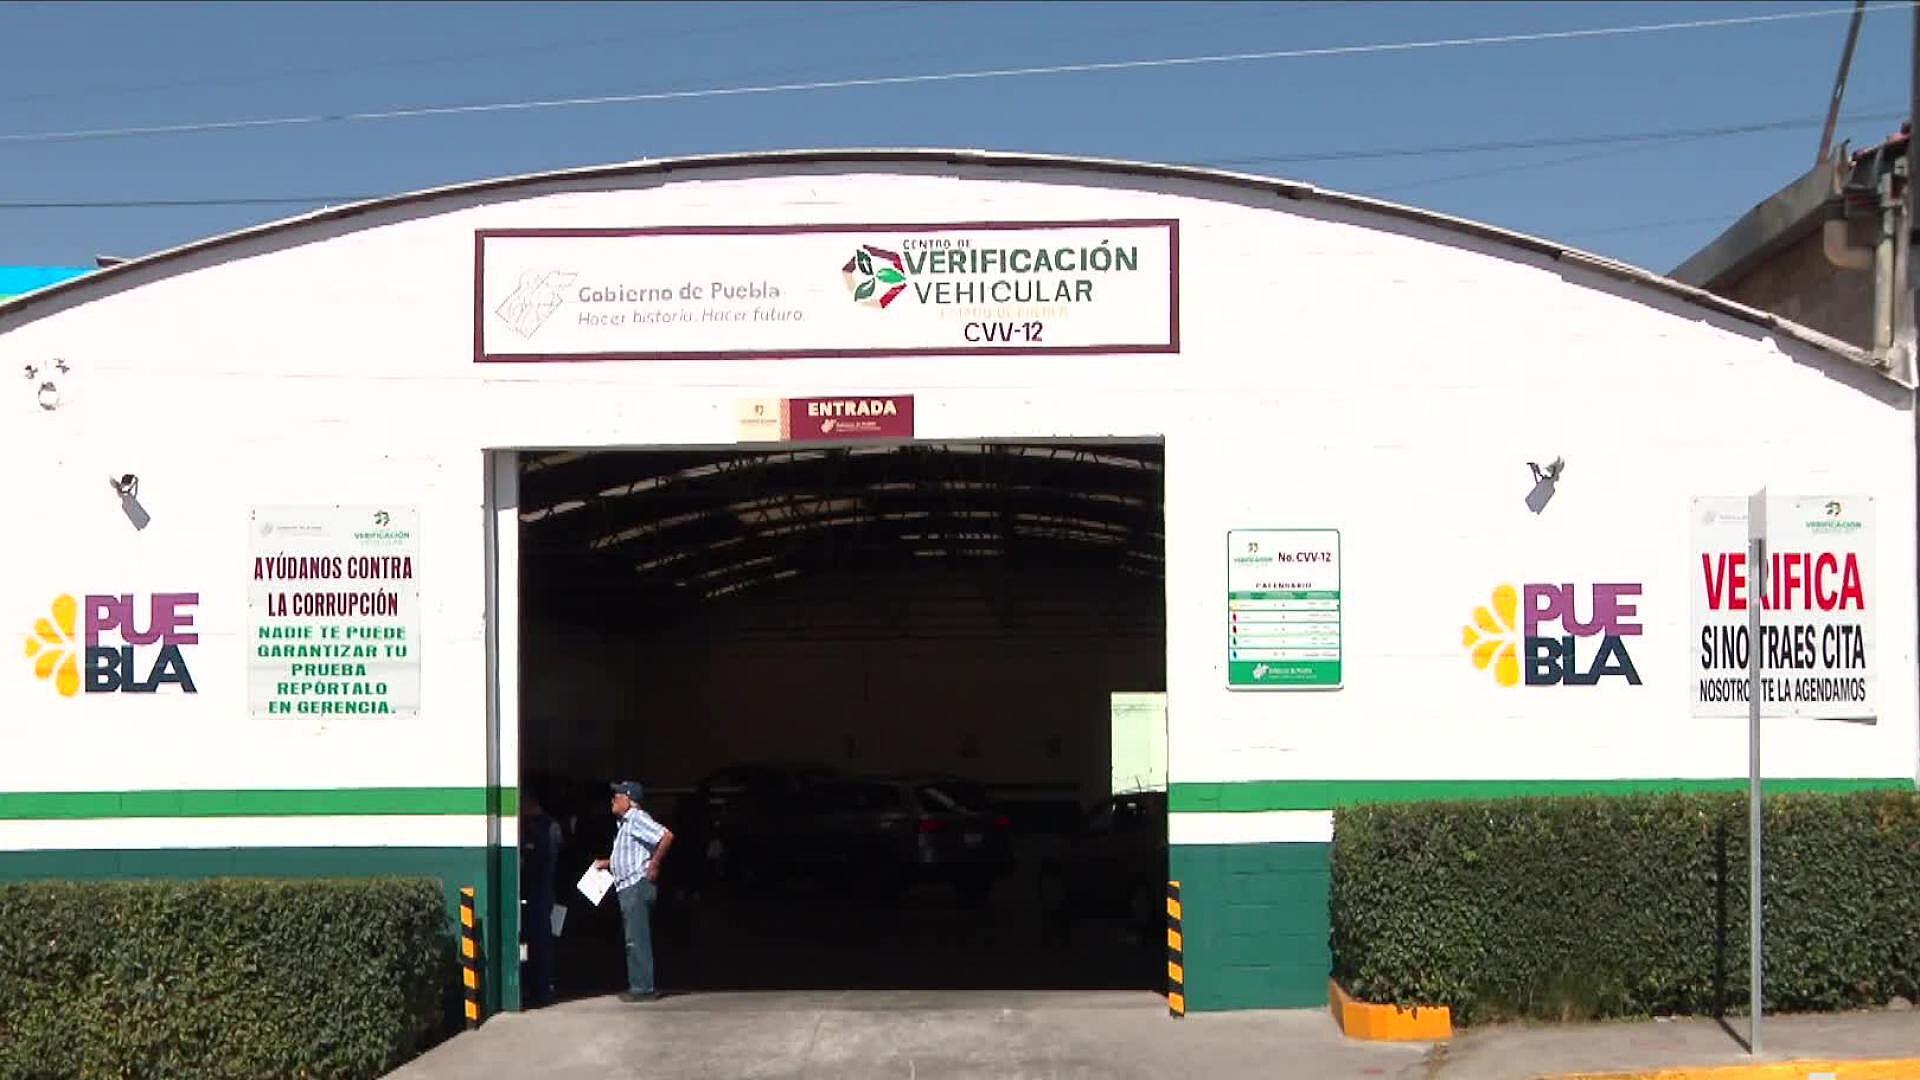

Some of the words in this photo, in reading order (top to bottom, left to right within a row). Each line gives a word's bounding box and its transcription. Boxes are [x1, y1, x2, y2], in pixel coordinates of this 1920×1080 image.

[903, 239, 951, 250] CENTRO
[903, 239, 1138, 275] VERIFICACIÓN
[579, 284, 673, 303] Gobierno
[679, 281, 703, 300] de
[711, 280, 780, 300] Puebla
[915, 279, 1093, 304] VEHICULAR
[964, 321, 1043, 342] CVV-12
[807, 400, 897, 417] ENTRADA
[254, 550, 342, 580] AYÚDANOS
[347, 556, 413, 579] CONTRA
[1278, 552, 1295, 563] No.
[268, 593, 288, 616] LA
[293, 587, 398, 617] CORRUPCIÓN
[1523, 583, 1643, 638] PUE
[85, 593, 199, 645] PUE
[259, 626, 313, 640] NADIE
[320, 626, 341, 640] TE
[346, 627, 407, 640] PUEDE
[257, 644, 378, 658] GARANTIZAR
[384, 645, 408, 658] TU
[1759, 624, 1816, 669] TRAES
[1822, 624, 1866, 669] CITA
[85, 644, 199, 694] BLA
[291, 663, 367, 677] PRUEBA
[1524, 635, 1643, 686] BLA
[277, 680, 388, 695] REPÓRTALO
[1700, 678, 1752, 702] NOSOTRO
[1760, 678, 1775, 702] TE
[1777, 678, 1792, 702] LA
[1794, 677, 1866, 702] AGENDAMOS
[268, 701, 291, 714] EN
[297, 701, 397, 714] GERENCIA.
